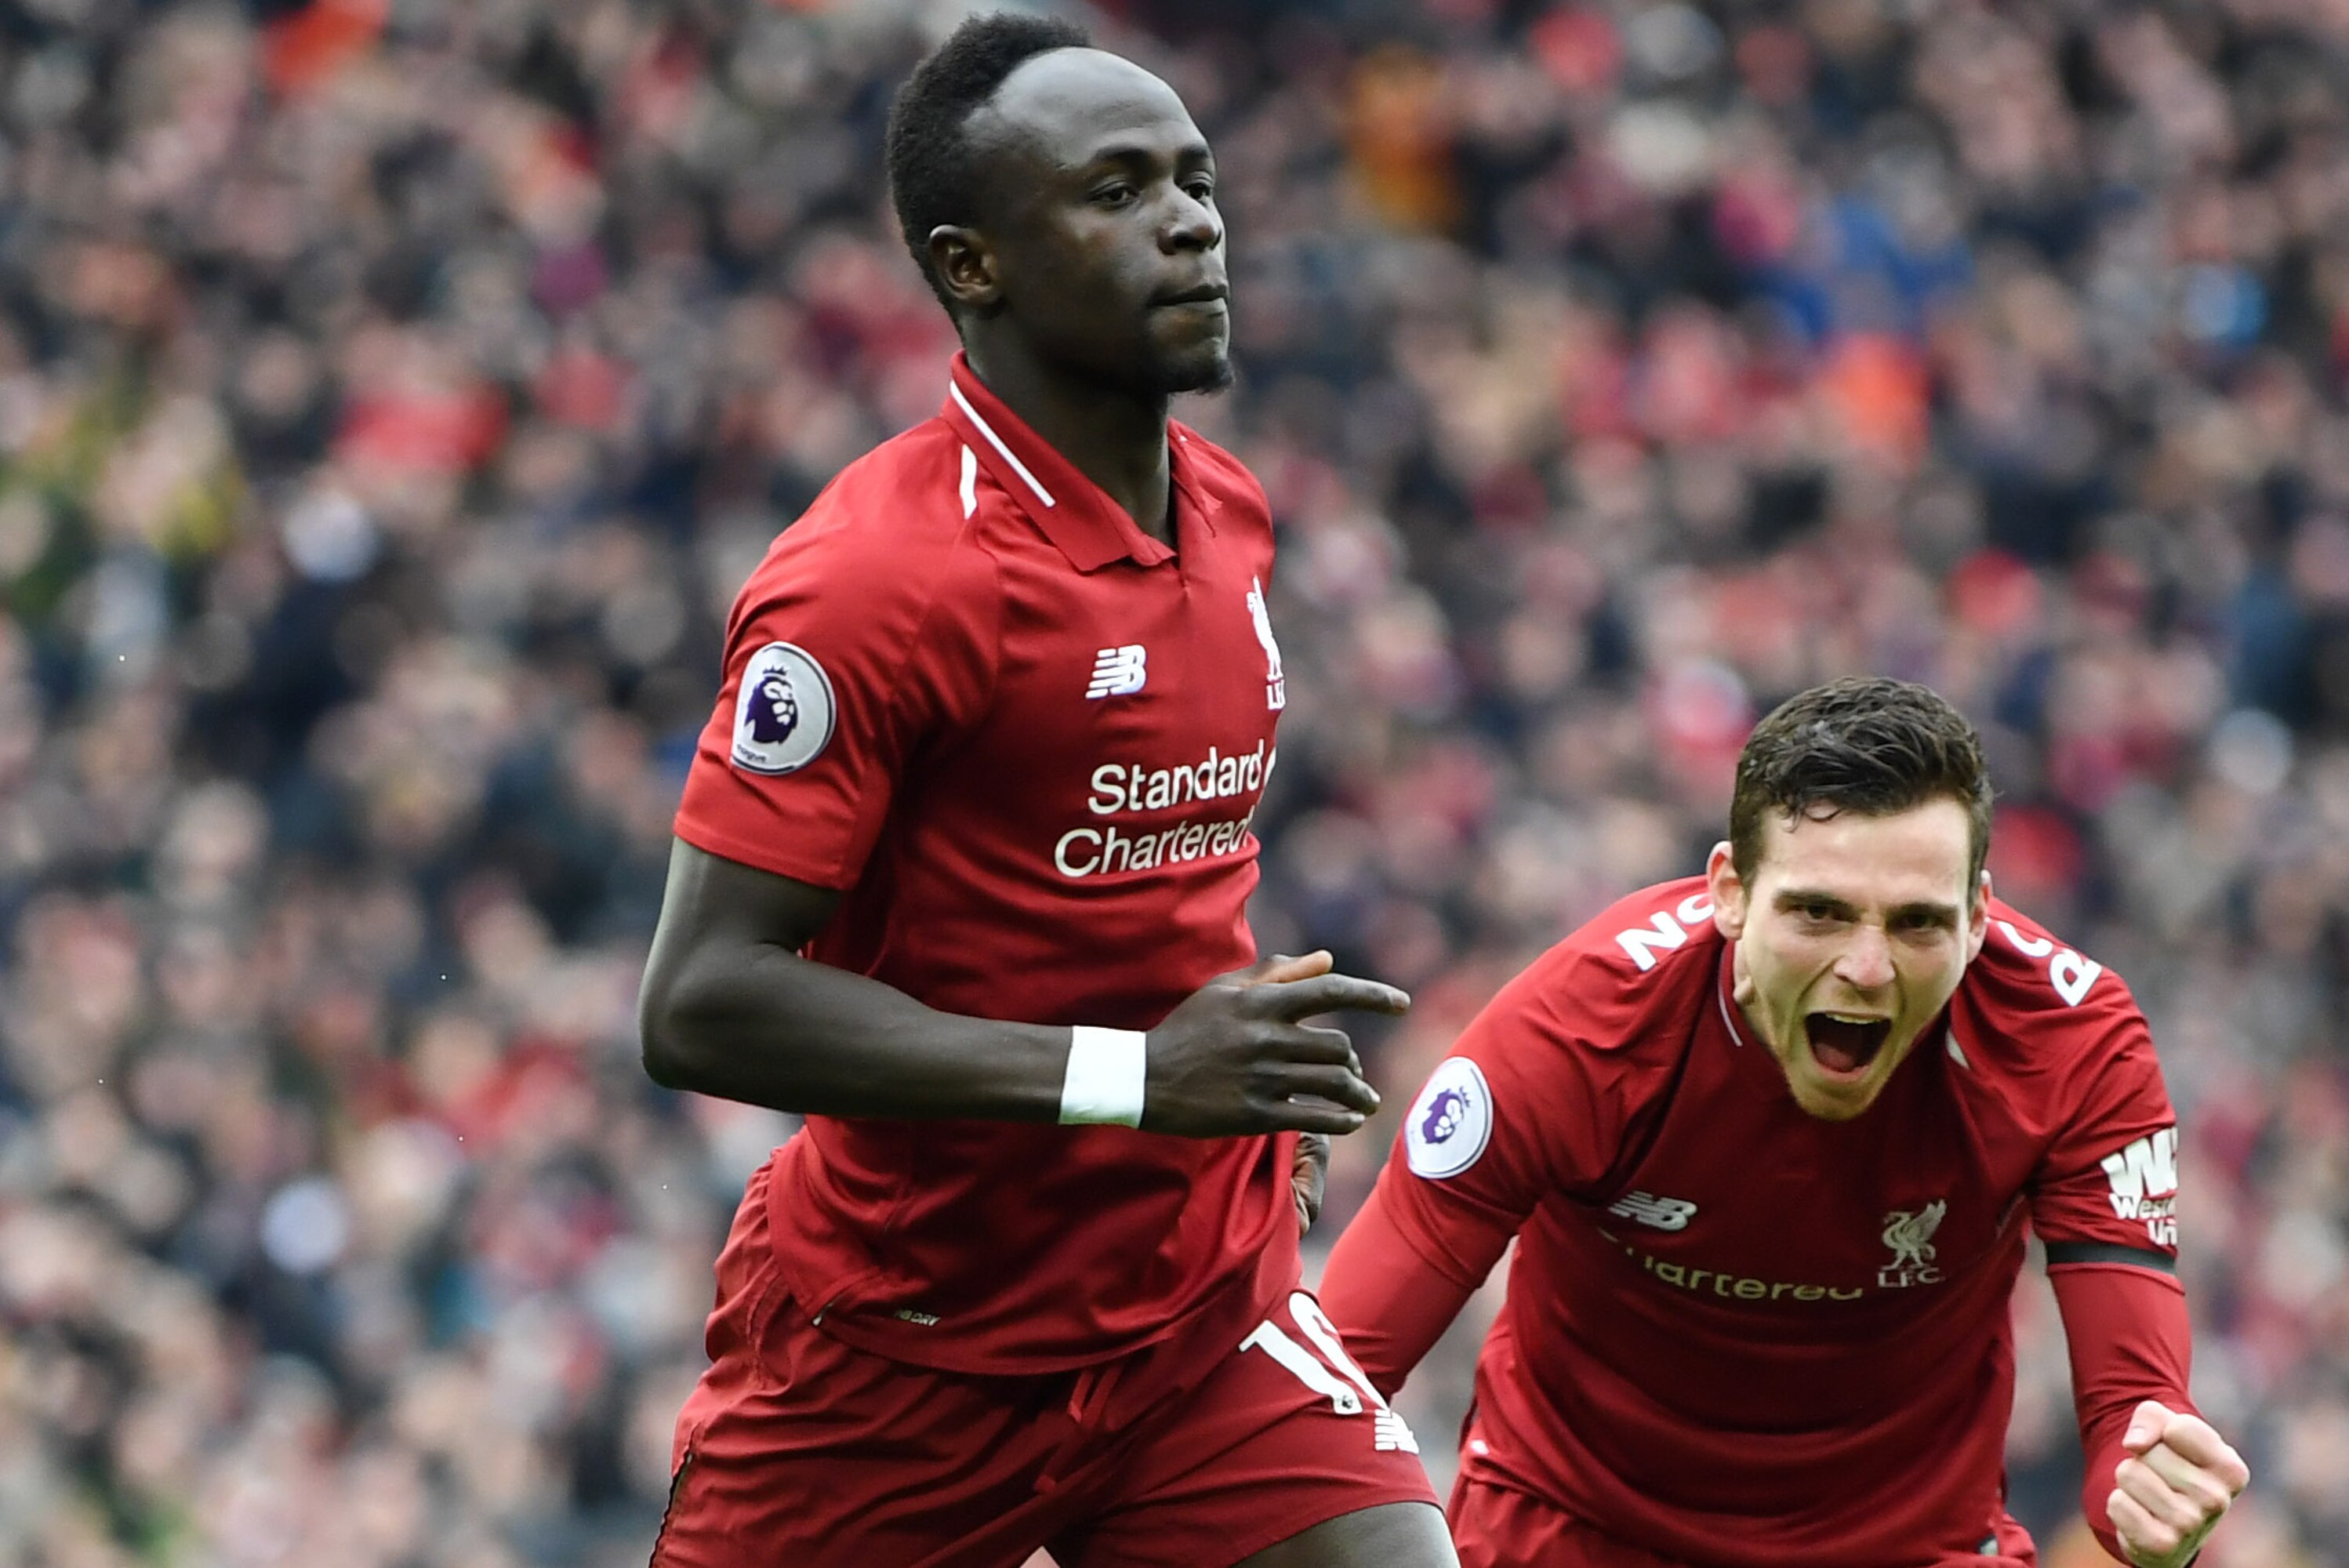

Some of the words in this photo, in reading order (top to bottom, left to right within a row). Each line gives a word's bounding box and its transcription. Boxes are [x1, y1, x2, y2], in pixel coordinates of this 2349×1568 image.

[1088, 739, 1264, 815] Standard
[1055, 804, 1255, 877] Chartered
[1596, 1227, 1864, 1301] artere
